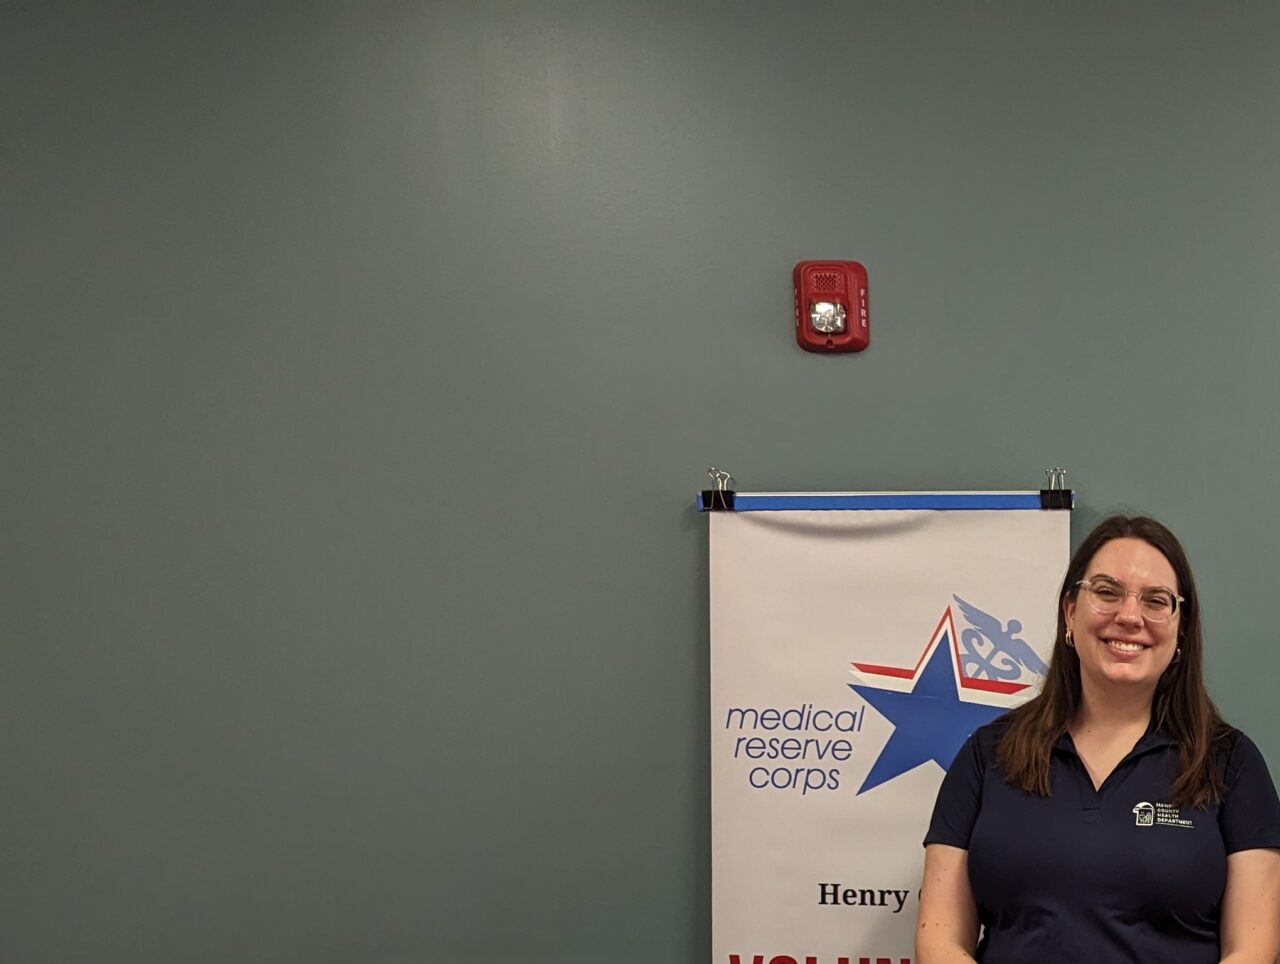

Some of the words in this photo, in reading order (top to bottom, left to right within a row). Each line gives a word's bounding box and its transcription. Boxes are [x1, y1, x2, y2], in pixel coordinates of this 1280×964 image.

[726, 704, 865, 733] medical
[734, 736, 853, 761] reserve
[749, 766, 840, 795] corps
[818, 883, 910, 914] Henry
